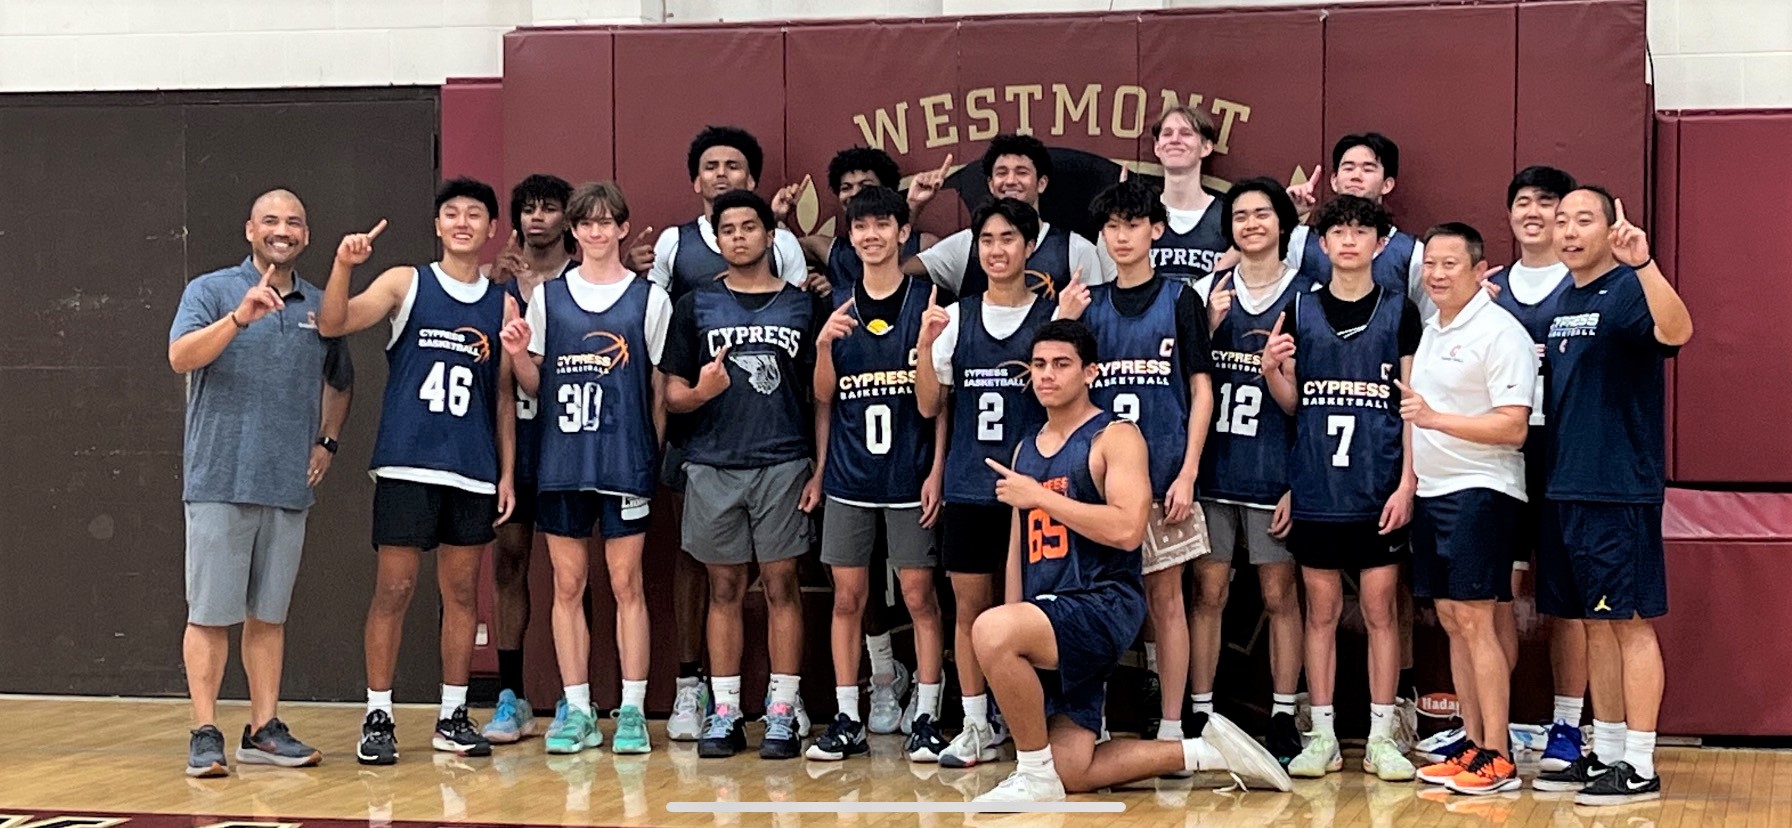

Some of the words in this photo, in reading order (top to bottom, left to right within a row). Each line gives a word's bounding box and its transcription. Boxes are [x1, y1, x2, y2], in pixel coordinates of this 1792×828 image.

[1149, 248, 1226, 273] YPRES
[418, 338, 481, 357] BASKETBALL
[419, 328, 466, 343] CYPRESS
[707, 325, 801, 358] CYPRESS
[1159, 338, 1175, 357] C
[1097, 359, 1172, 377] YPRESS
[1211, 350, 1262, 366] CYPRES
[963, 368, 1009, 378] CYPRESS
[419, 361, 474, 417] 46
[839, 386, 913, 401] BASKETBAL
[1303, 380, 1391, 399] CYPRESS
[557, 382, 603, 432] 30
[977, 391, 1004, 441] 2
[1216, 382, 1263, 437] 12
[864, 404, 892, 455] 0
[1327, 415, 1355, 467] 7
[1028, 507, 1069, 565] 65
